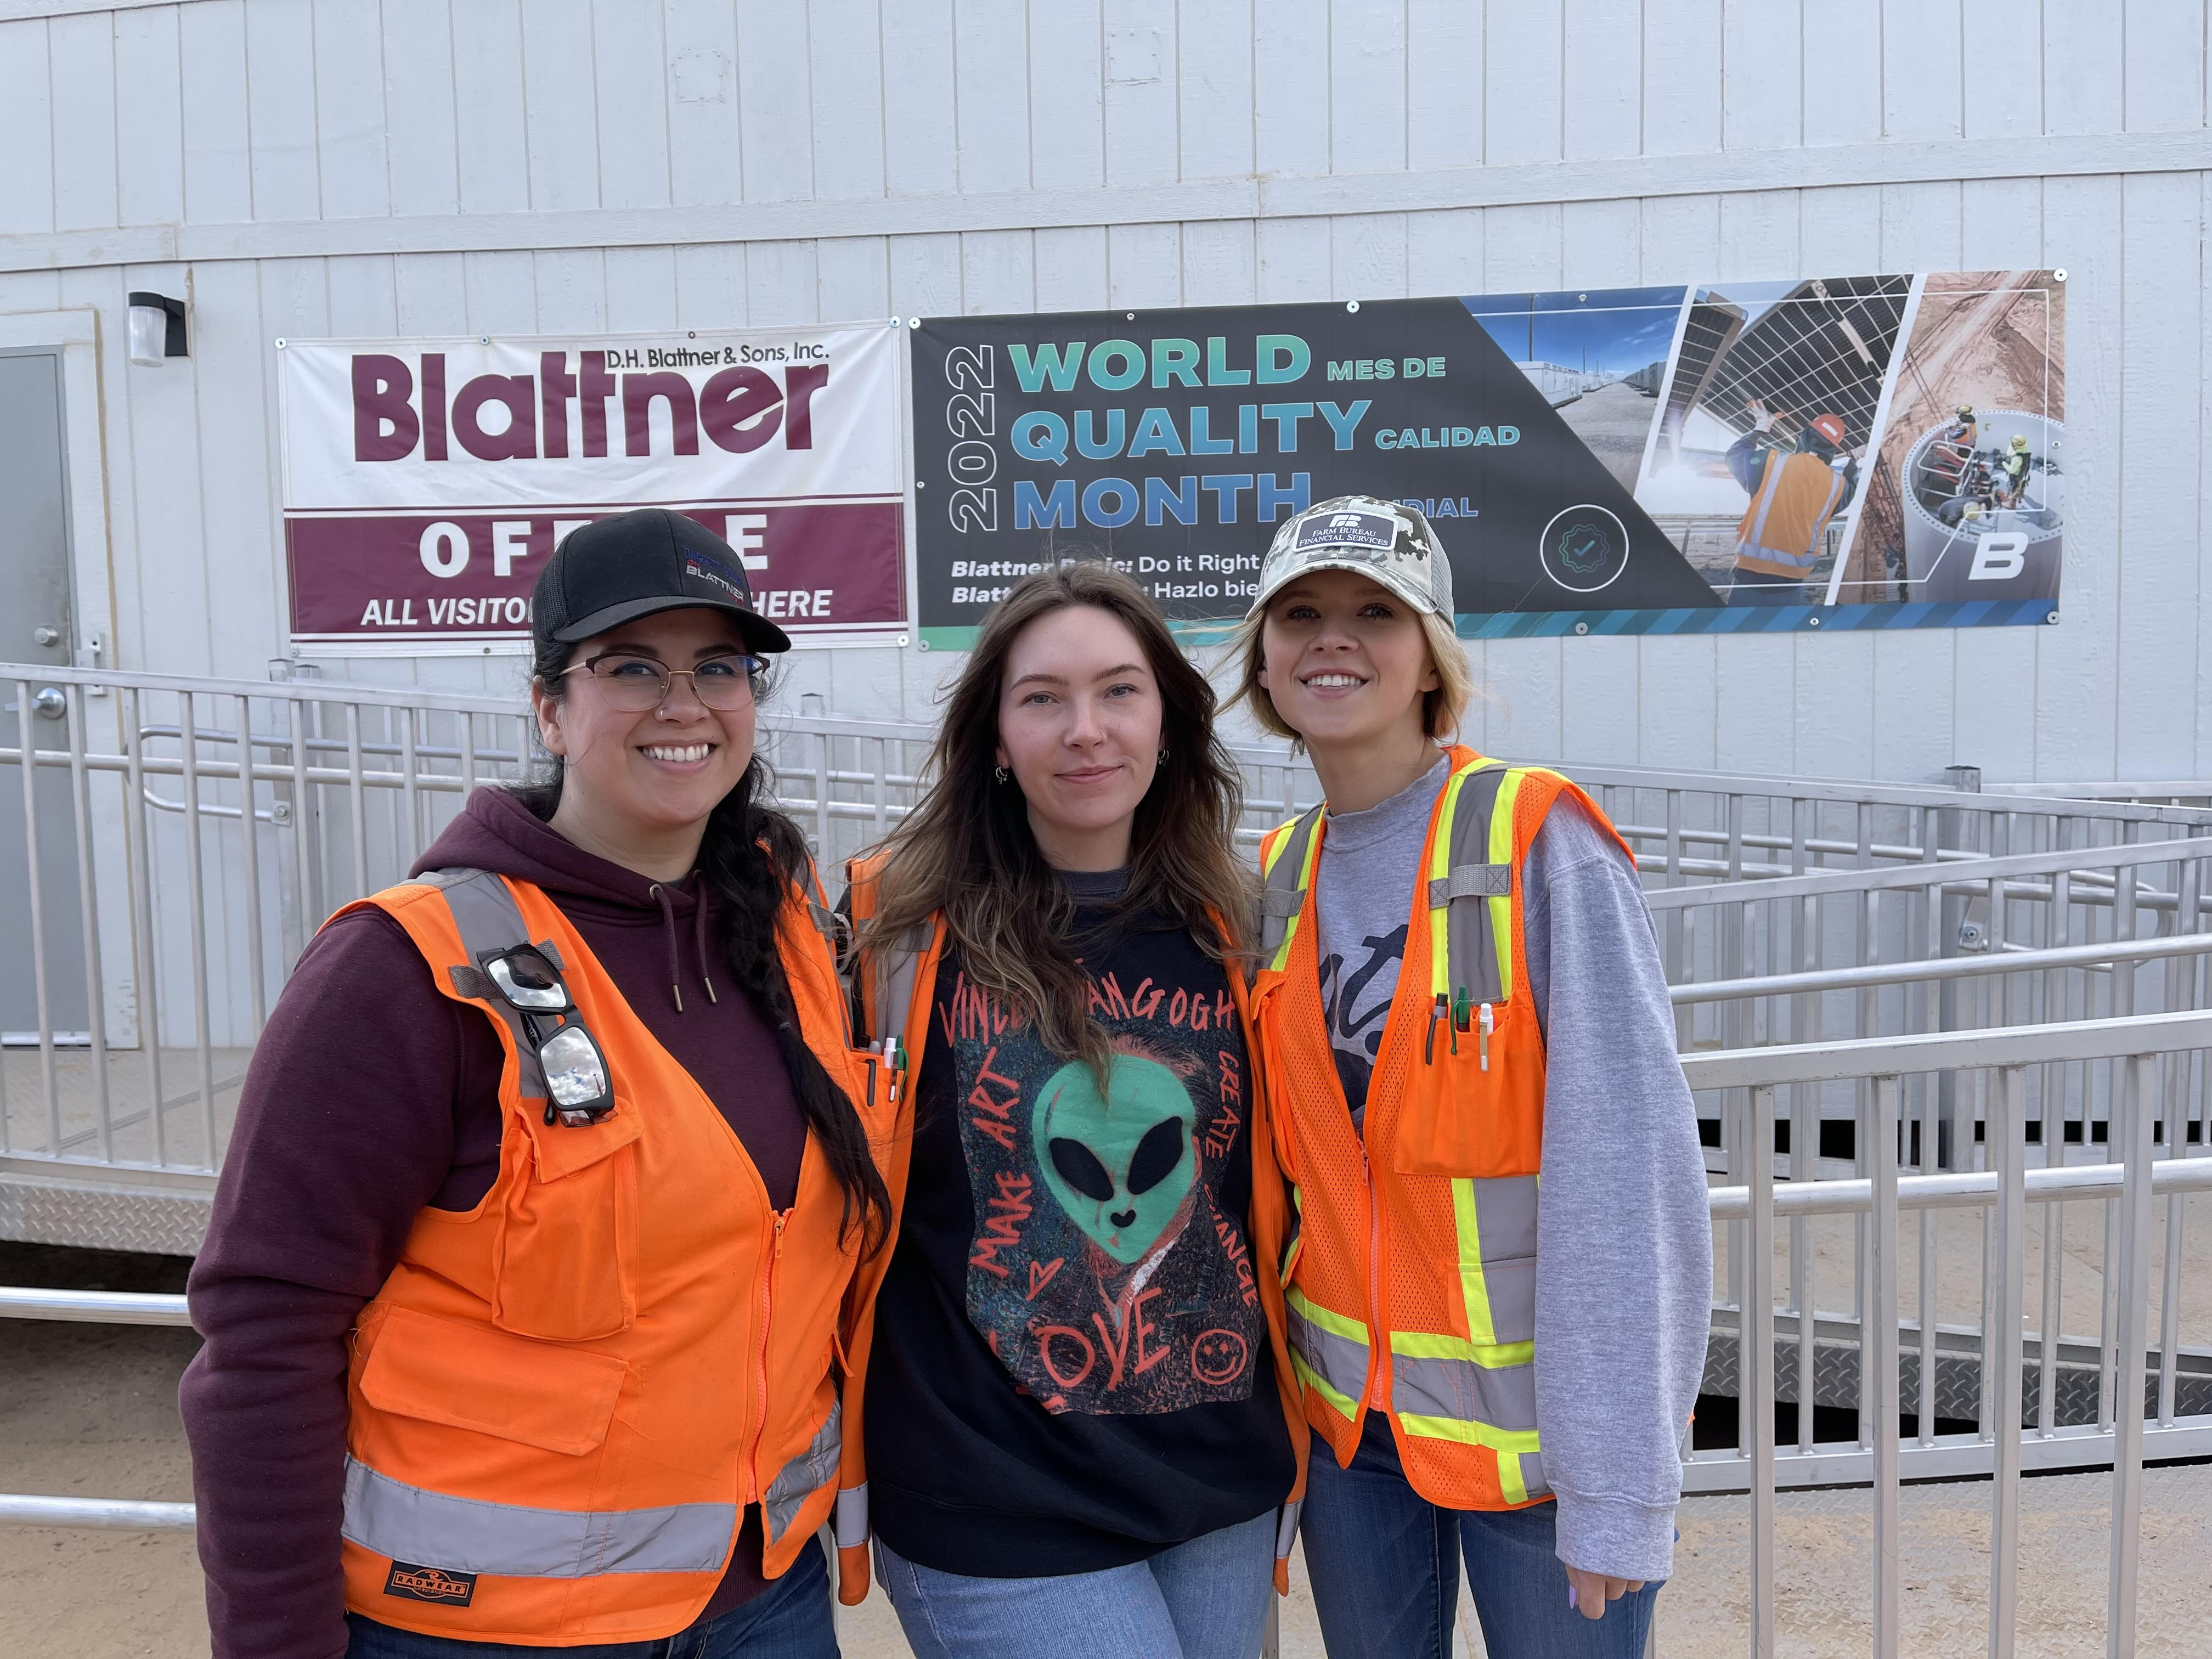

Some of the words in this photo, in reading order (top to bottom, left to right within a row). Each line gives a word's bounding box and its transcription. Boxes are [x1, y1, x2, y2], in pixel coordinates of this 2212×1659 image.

[607, 349, 644, 368] D.H.
[648, 347, 720, 368] Blattner
[724, 346, 736, 364] &
[740, 345, 790, 363] Sons,
[794, 342, 830, 360] Inc.
[1007, 334, 1311, 393] WORLD
[1327, 358, 1395, 381] MES
[1403, 357, 1446, 378] DE
[351, 350, 829, 462] Blattner
[945, 344, 997, 534] 2022
[1010, 400, 1373, 466] QUALITY
[1375, 426, 1520, 450] CALIDAD
[1013, 472, 1311, 531] MONTH
[1392, 496, 1479, 518] DIAL
[1299, 535, 1344, 546] FINANCIAL
[1347, 534, 1389, 546] SERVICES
[1312, 528, 1336, 537] FARM
[1339, 527, 1376, 537] BUREAU
[1138, 556, 1170, 572] Do
[1177, 555, 1193, 571] it
[1198, 554, 1260, 574] Right
[1967, 531, 2029, 580] B
[686, 565, 744, 601] BLATTNER
[1154, 581, 1219, 598] Hazlo
[360, 599, 418, 625] ALL
[427, 596, 533, 625] VISITO
[752, 589, 833, 618] HERE
[968, 1047, 1020, 1150] ART
[1205, 1049, 1241, 1160] CREATE
[969, 1170, 1033, 1278] MAKE
[397, 1575, 461, 1593] RADWEAR
